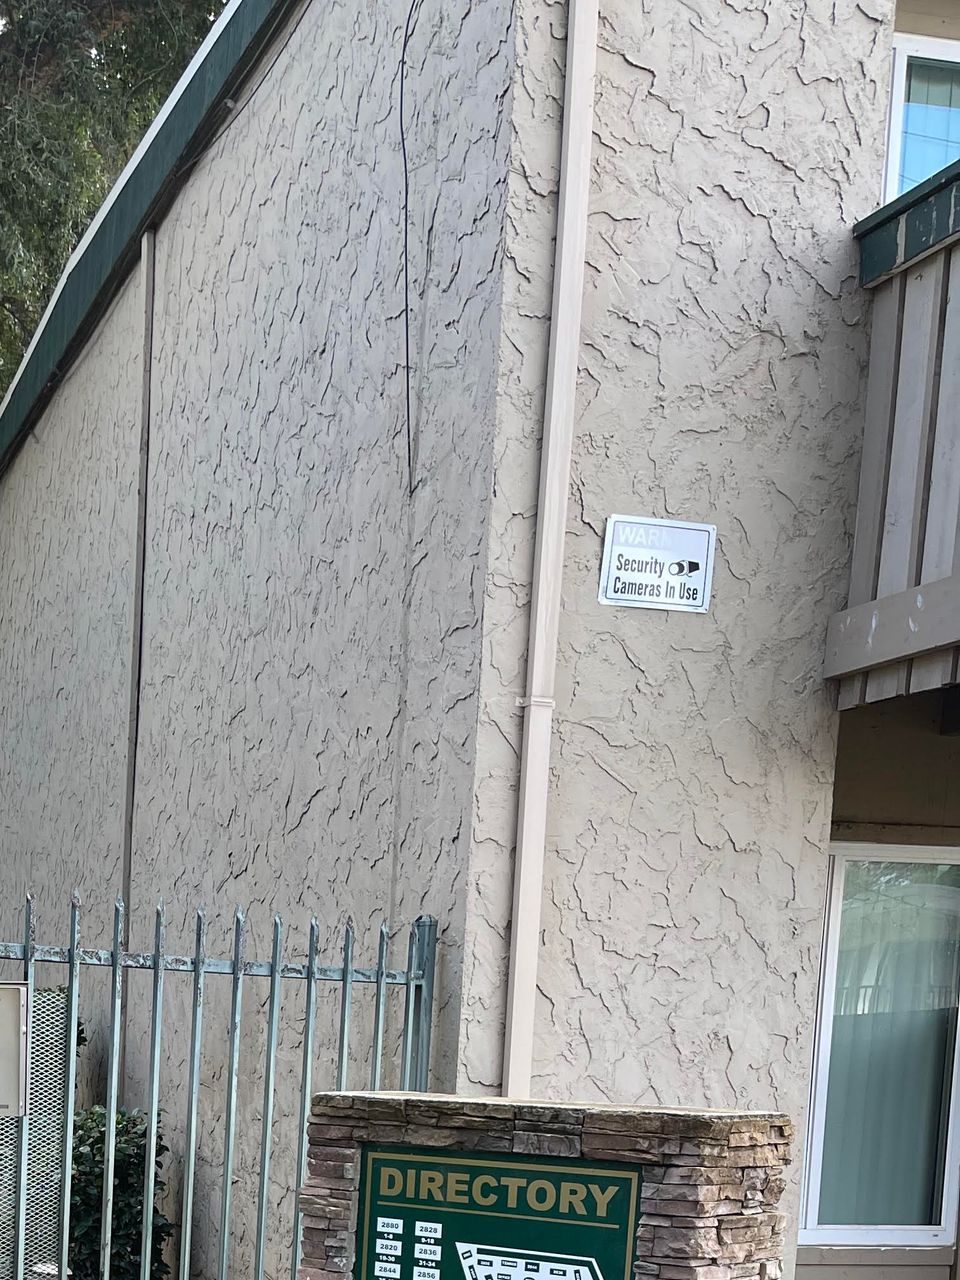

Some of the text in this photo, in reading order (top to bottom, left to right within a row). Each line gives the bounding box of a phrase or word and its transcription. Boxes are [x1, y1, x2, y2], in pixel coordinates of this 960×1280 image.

[616, 553, 665, 579] Security
[613, 576, 699, 601] Cameras In Use
[379, 1167, 620, 1218] DIRECTORY
[419, 1225, 438, 1234] 2828
[380, 1243, 398, 1251] 2820
[418, 1248, 437, 1256] 2836
[378, 1266, 397, 1274] 2844
[417, 1271, 436, 1280] 2856
